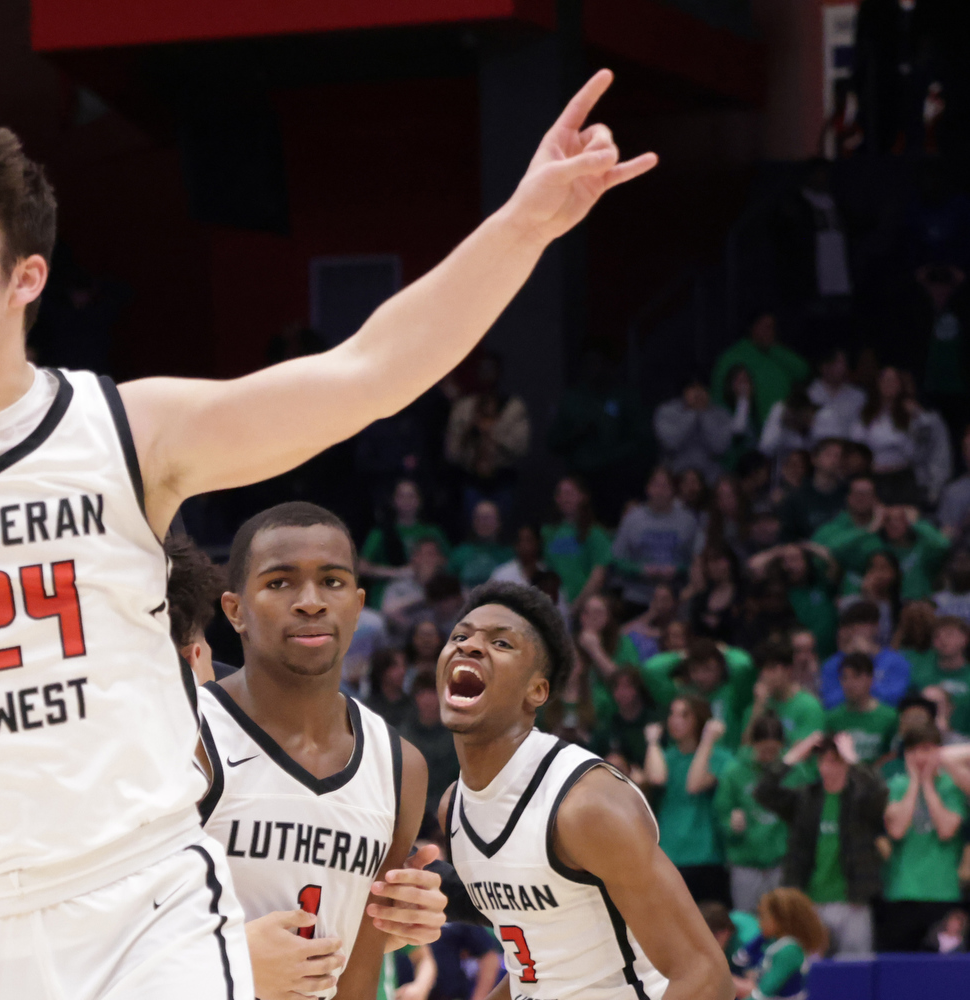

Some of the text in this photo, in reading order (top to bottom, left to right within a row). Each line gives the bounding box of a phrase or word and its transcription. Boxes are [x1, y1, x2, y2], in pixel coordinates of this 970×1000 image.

[227, 820, 387, 878] LUTHERAN
[297, 884, 322, 940] 1
[467, 881, 560, 911] UTHERAN
[499, 925, 539, 983] 3
